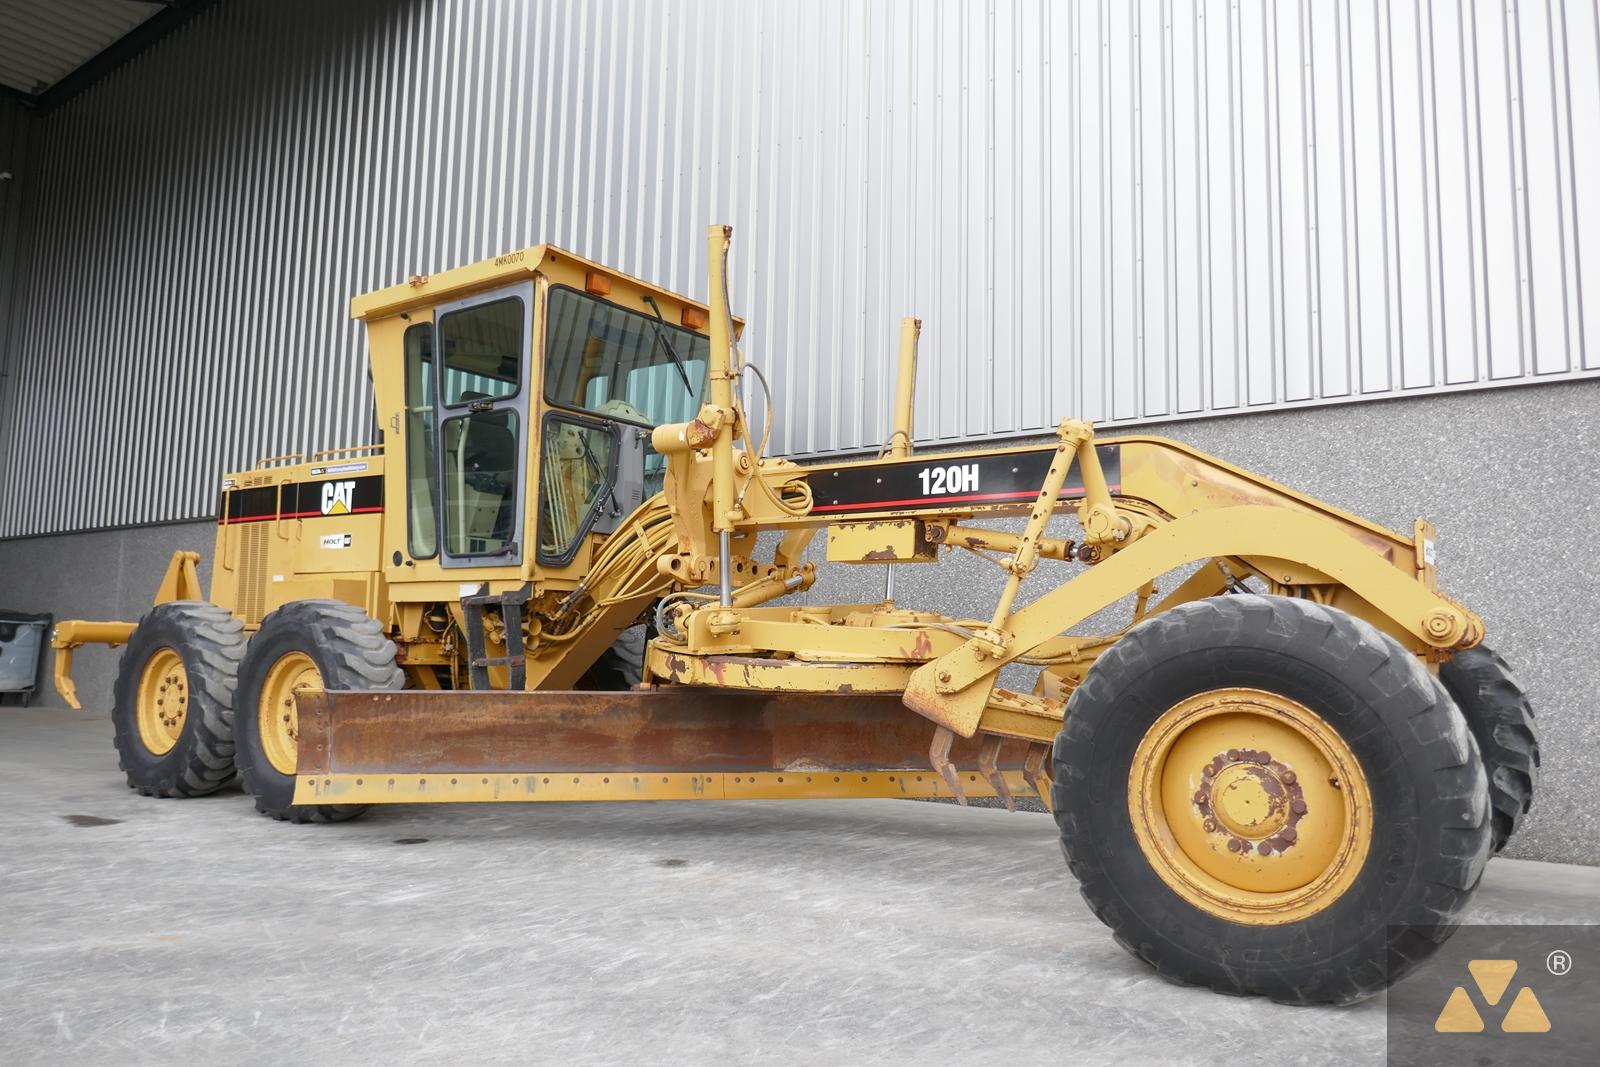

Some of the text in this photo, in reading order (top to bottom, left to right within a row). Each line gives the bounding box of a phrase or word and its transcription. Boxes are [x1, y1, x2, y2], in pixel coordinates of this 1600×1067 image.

[494, 251, 525, 266] 4MK0070
[918, 463, 979, 496] 120H
[321, 481, 356, 516] CAT
